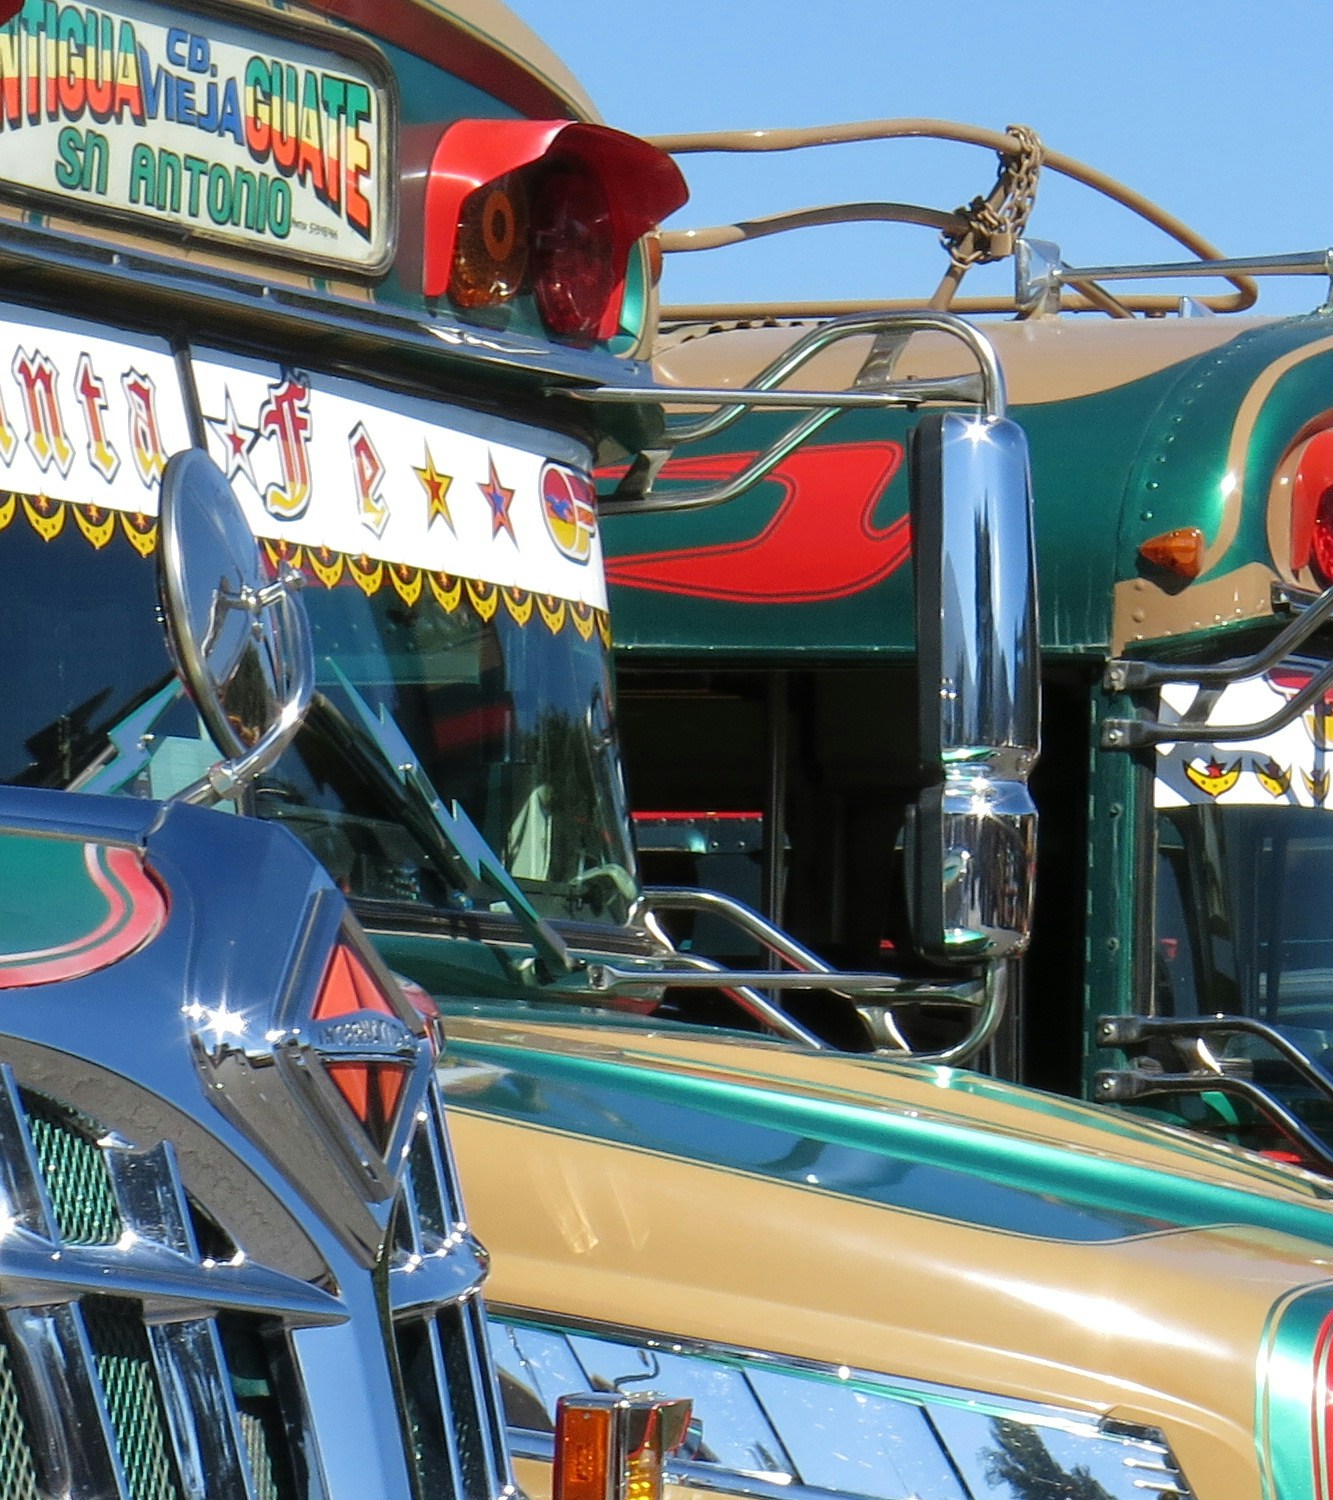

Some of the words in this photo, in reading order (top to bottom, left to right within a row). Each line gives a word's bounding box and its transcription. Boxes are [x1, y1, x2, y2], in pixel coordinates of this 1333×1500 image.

[0, 0, 147, 132] NTIGUA
[138, 41, 245, 146] VIEJA
[245, 55, 372, 244] GUATE
[166, 27, 219, 78] CD.
